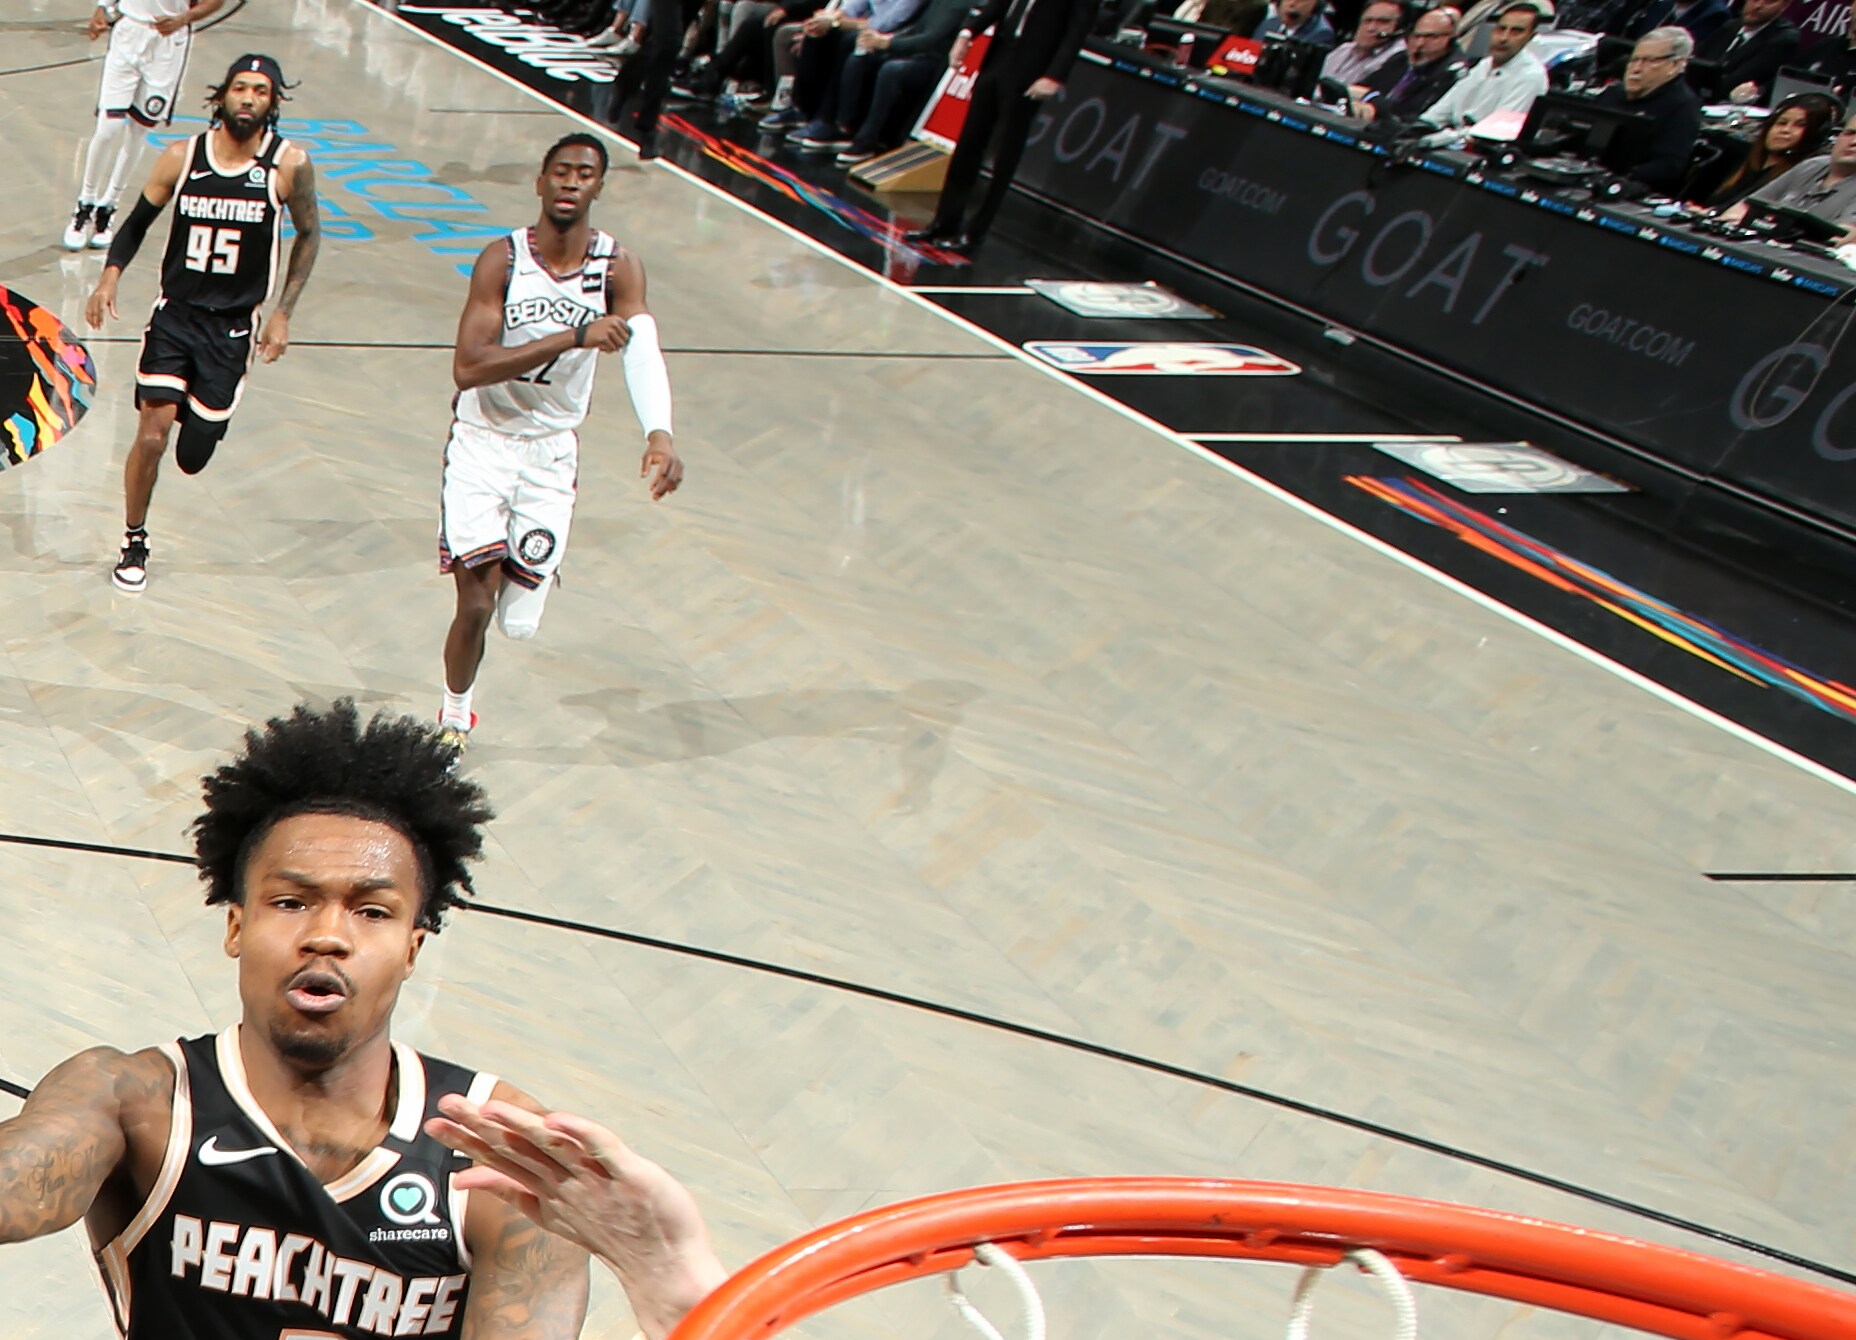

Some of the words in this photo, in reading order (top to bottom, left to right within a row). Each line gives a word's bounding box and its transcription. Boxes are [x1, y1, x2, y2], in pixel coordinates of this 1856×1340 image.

[180, 194, 267, 223] PEACHTREE
[185, 224, 242, 275] 95
[1308, 190, 1549, 325] GOAT
[1567, 304, 1696, 367] GOAT.COM
[369, 1226, 449, 1242] sharecare
[170, 1213, 468, 1338] PEACHTREE
